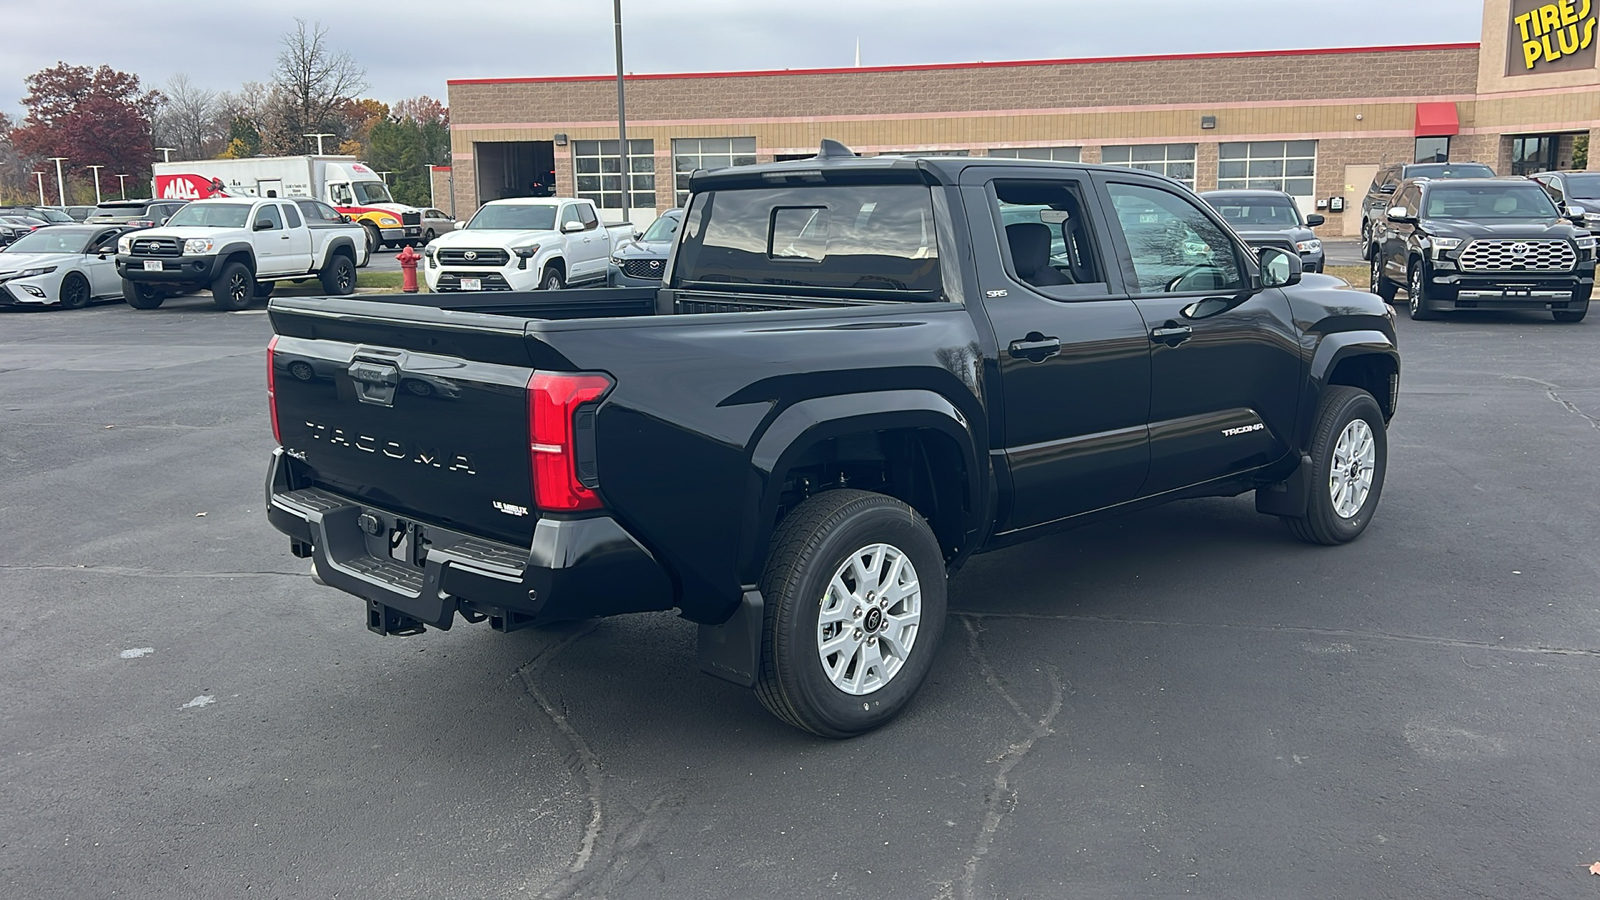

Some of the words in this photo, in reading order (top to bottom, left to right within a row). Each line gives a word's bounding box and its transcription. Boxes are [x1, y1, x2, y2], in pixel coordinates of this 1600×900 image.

[1514, 0, 1591, 42] TIRES
[1522, 16, 1596, 70] PLUS
[163, 177, 200, 199] MAC
[305, 420, 476, 475] TACOMA
[1221, 423, 1264, 436] TACOMA
